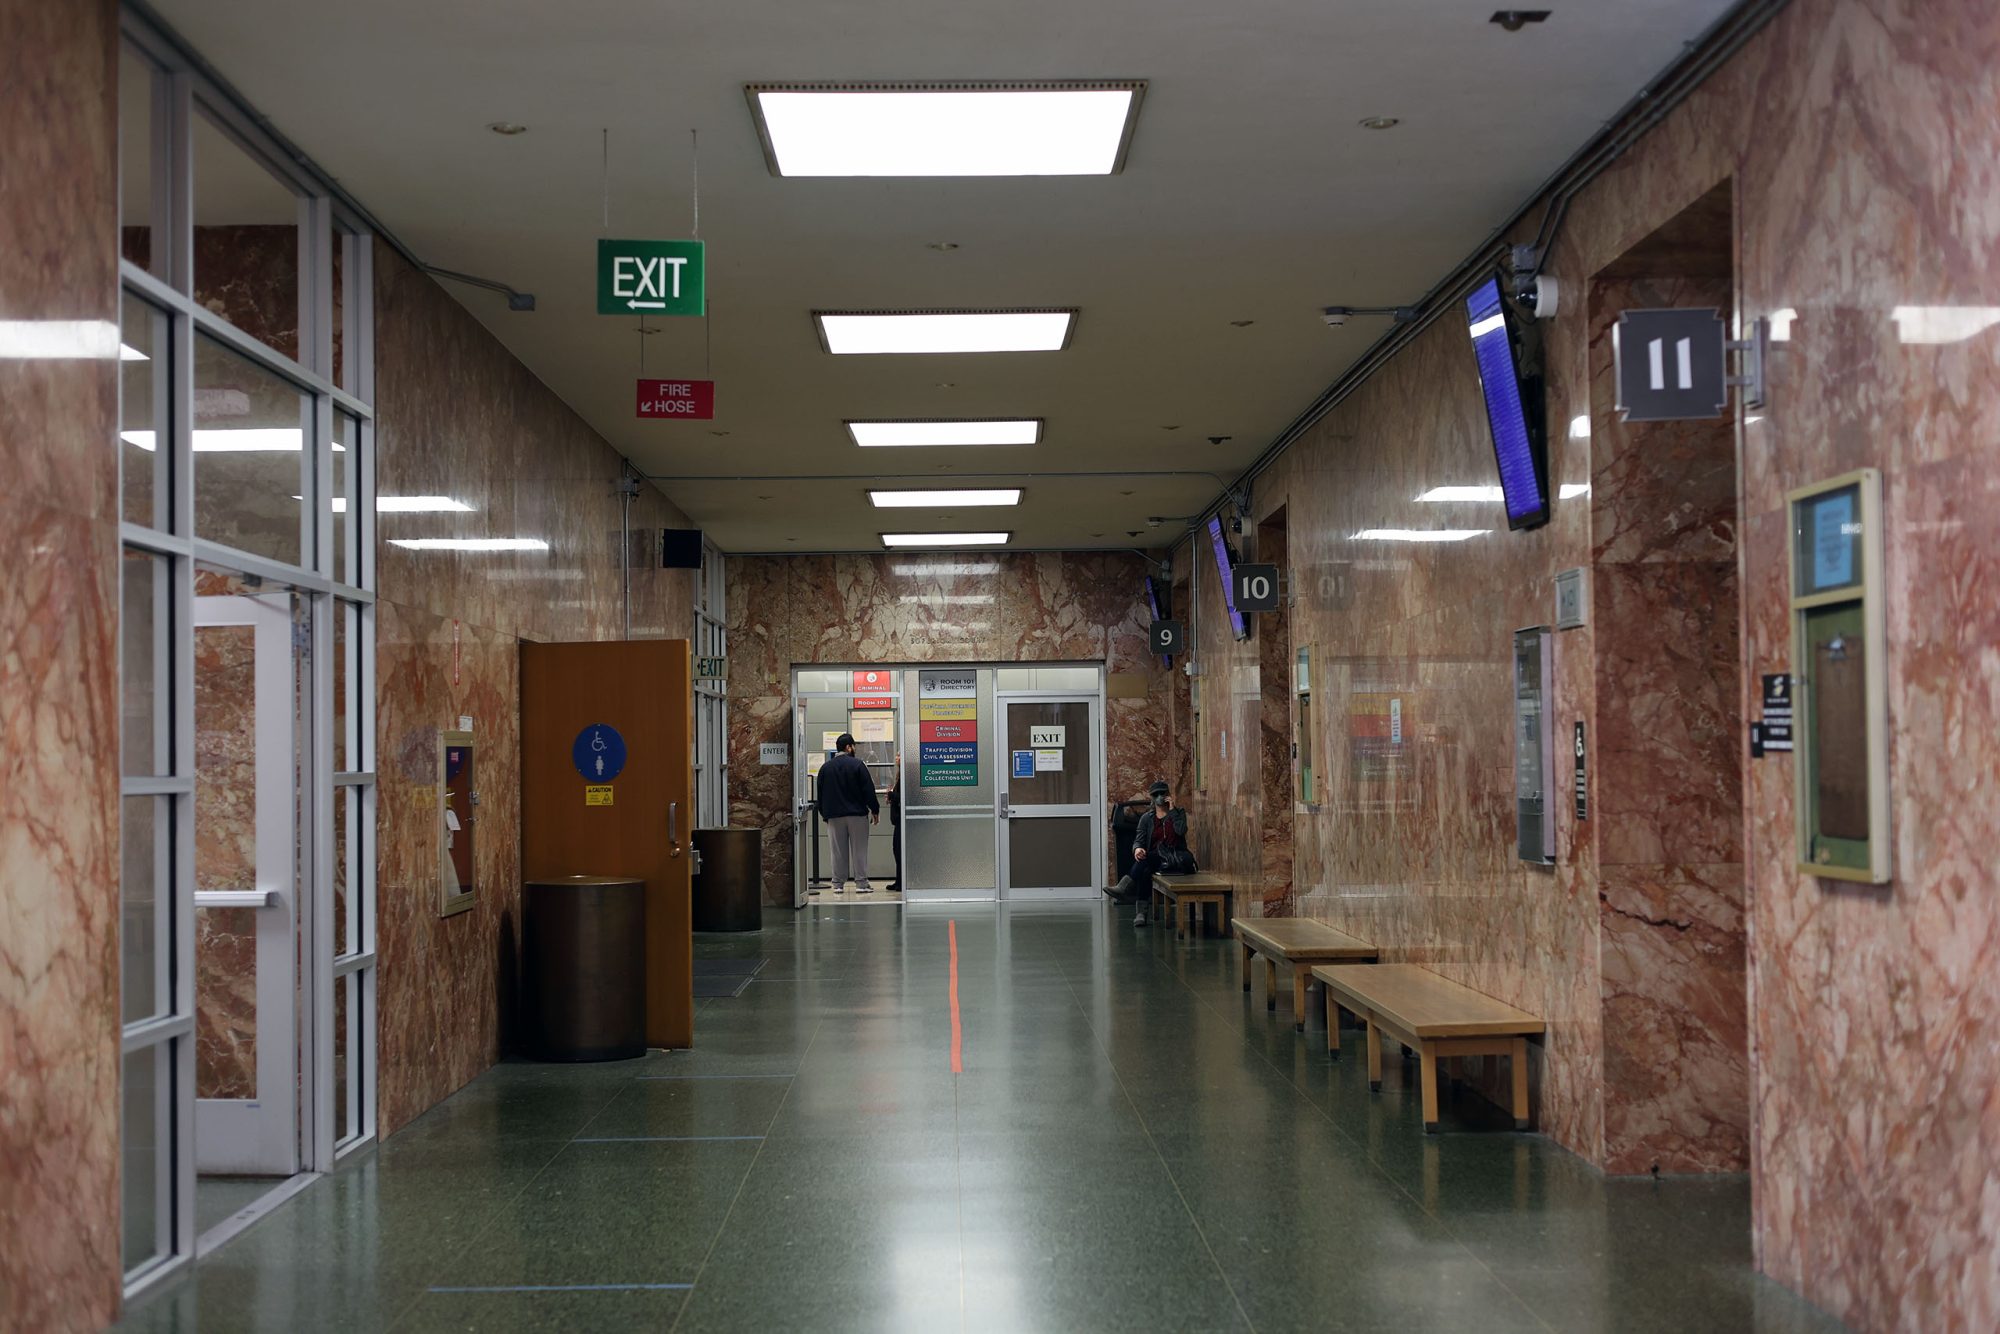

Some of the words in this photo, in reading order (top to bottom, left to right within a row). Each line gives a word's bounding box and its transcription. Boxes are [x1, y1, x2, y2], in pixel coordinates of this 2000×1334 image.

[613, 257, 688, 298] EXIT
[1648, 336, 1693, 390] 11
[659, 384, 692, 397] FIRE
[654, 400, 696, 413] HOSE
[1242, 576, 1270, 599] 10
[1160, 629, 1173, 646] 9
[700, 658, 725, 676] EXIT
[1033, 733, 1061, 743] EXIT
